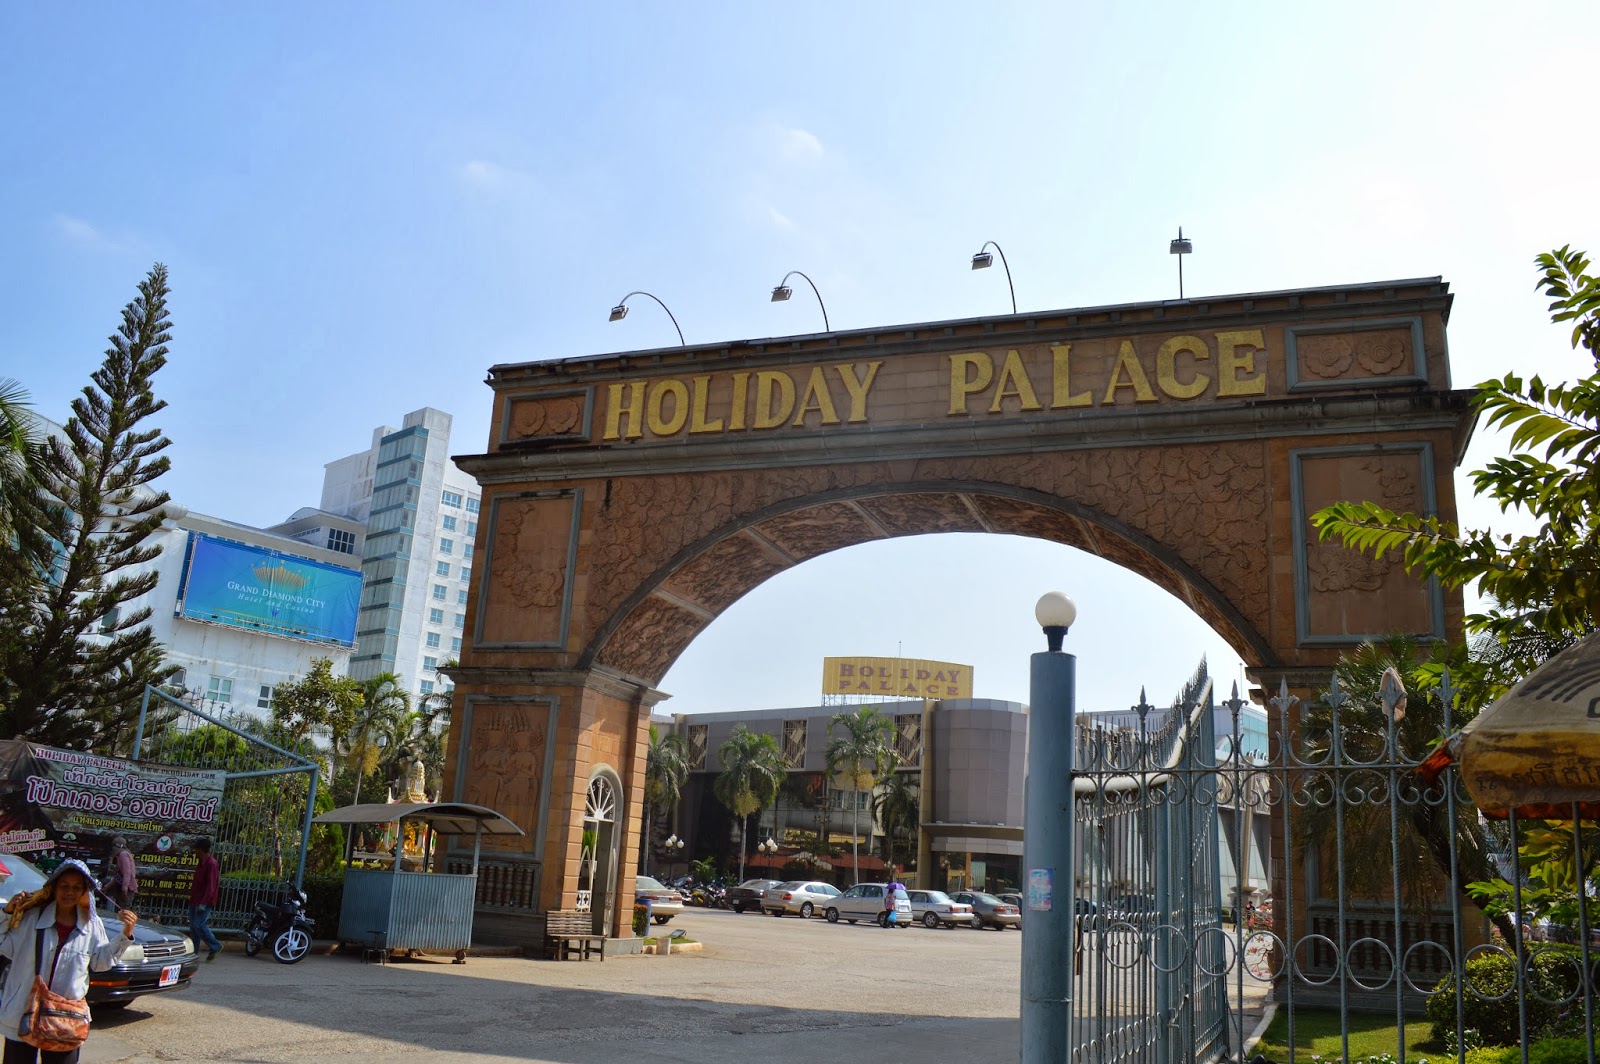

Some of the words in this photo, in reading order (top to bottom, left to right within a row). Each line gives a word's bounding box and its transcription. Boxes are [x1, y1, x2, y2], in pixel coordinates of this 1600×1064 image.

[603, 360, 885, 441] HOLIDAY
[947, 329, 1267, 416] PALACE
[227, 581, 259, 595] GRAND
[262, 588, 303, 604] DIAMOND
[306, 597, 326, 609] CITY
[237, 593, 263, 604] Hotel
[265, 599, 282, 608] and
[284, 603, 315, 614] Casino
[839, 663, 961, 683] HOLIDAY
[838, 680, 959, 696] PALACE
[35, 748, 84, 766] HOLIDAY
[63, 766, 124, 789] เท็กซัส
[128, 796, 218, 822] ออนไลน์
[164, 856, 177, 864] 24
